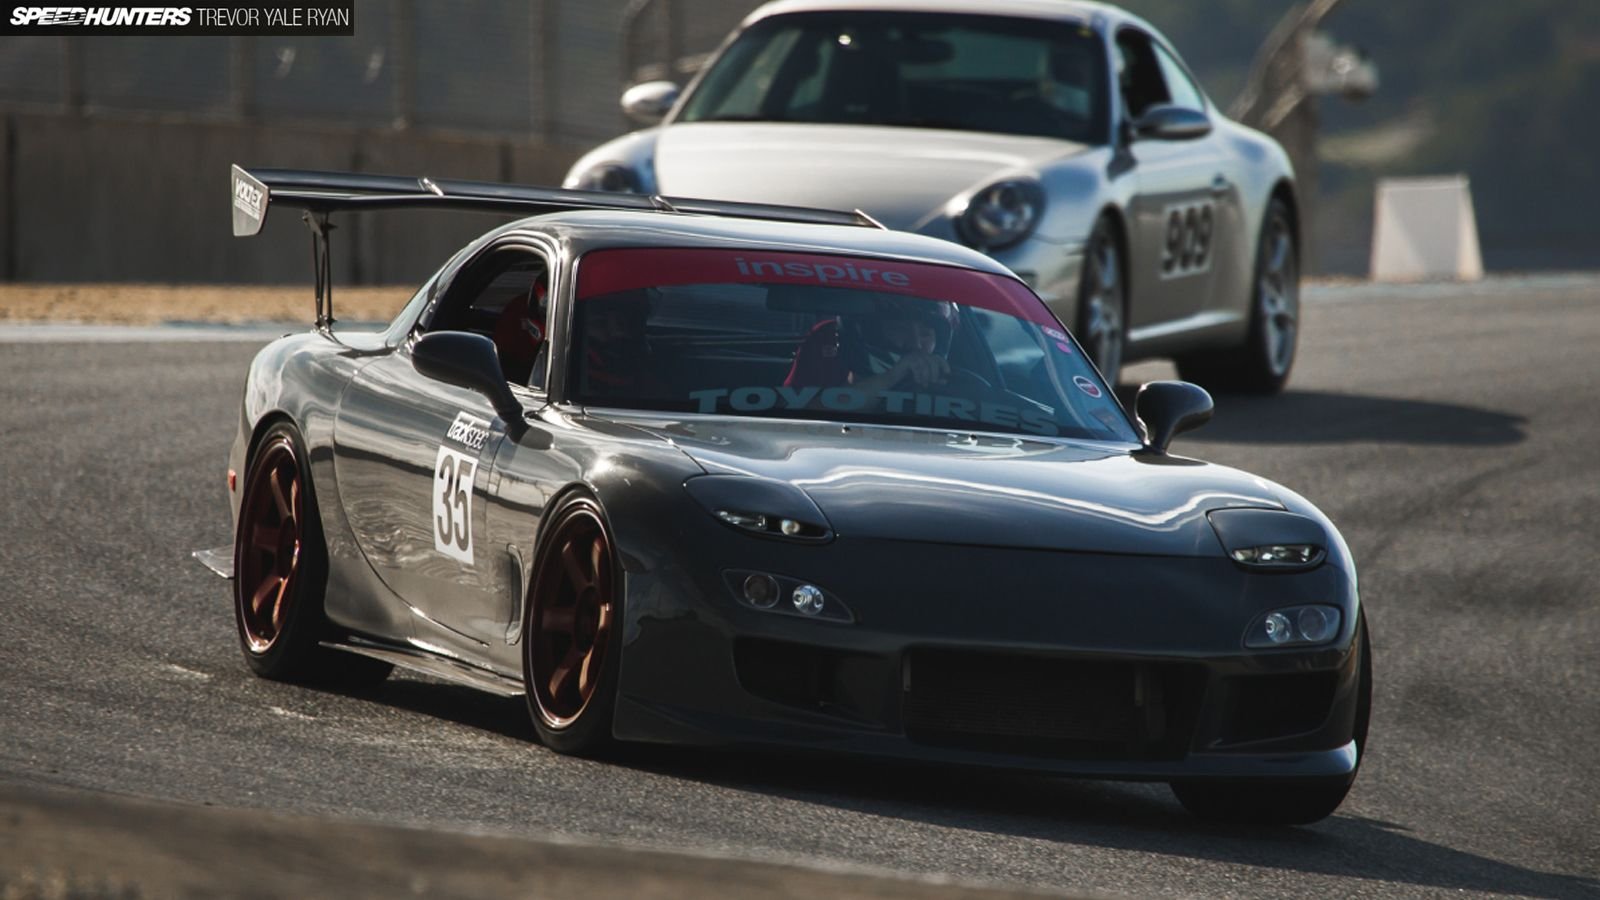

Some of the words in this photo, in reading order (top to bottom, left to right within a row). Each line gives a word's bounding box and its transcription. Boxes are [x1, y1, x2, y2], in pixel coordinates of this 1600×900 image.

[1163, 203, 1214, 273] 909
[735, 257, 911, 286] inspire
[689, 387, 867, 412] TOYO
[877, 391, 1058, 435] TIRES
[437, 454, 473, 552] 35
